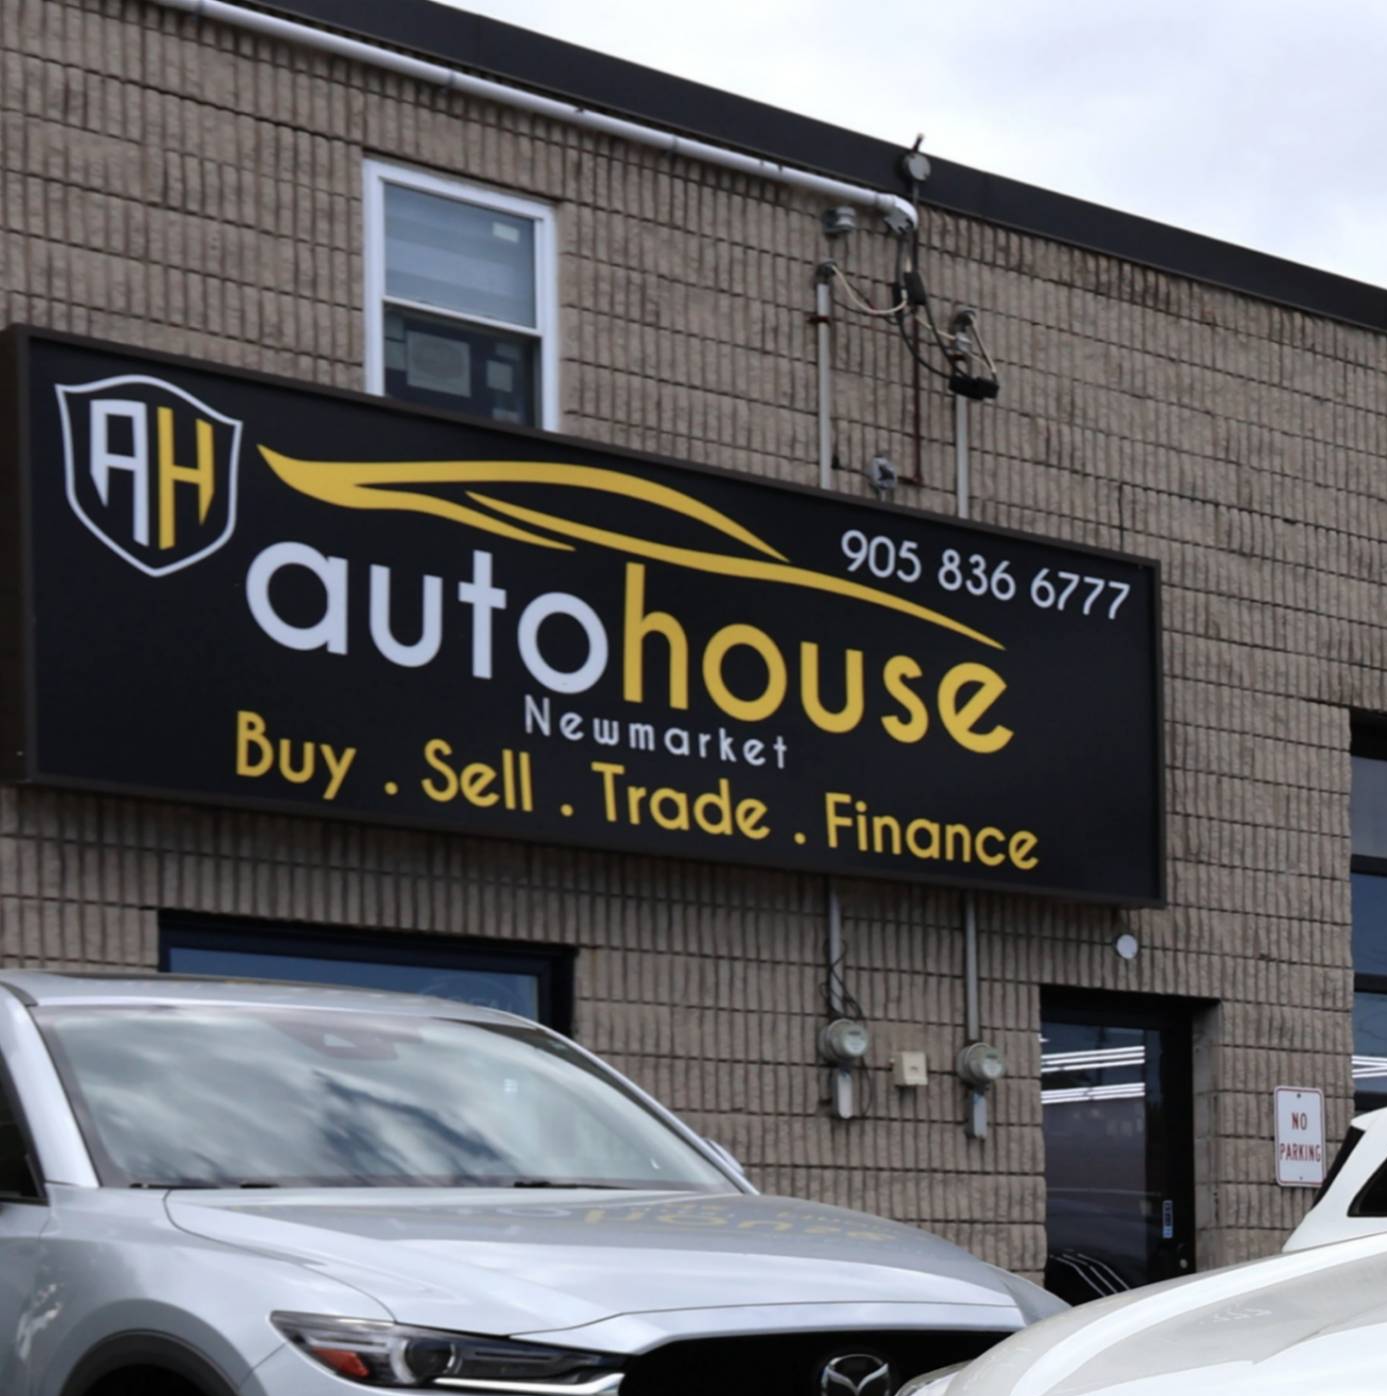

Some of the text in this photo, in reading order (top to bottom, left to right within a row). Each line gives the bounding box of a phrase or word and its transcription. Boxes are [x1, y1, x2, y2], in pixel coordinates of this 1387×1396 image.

[89, 399, 215, 550] AH
[841, 529, 1130, 620] 905 836 6777
[524, 695, 788, 769] Newmarket
[236, 710, 1040, 871] Buy Sell Trade Finance
[1279, 1143, 1321, 1162] PARKING
[1291, 1112, 1307, 1131] NO
